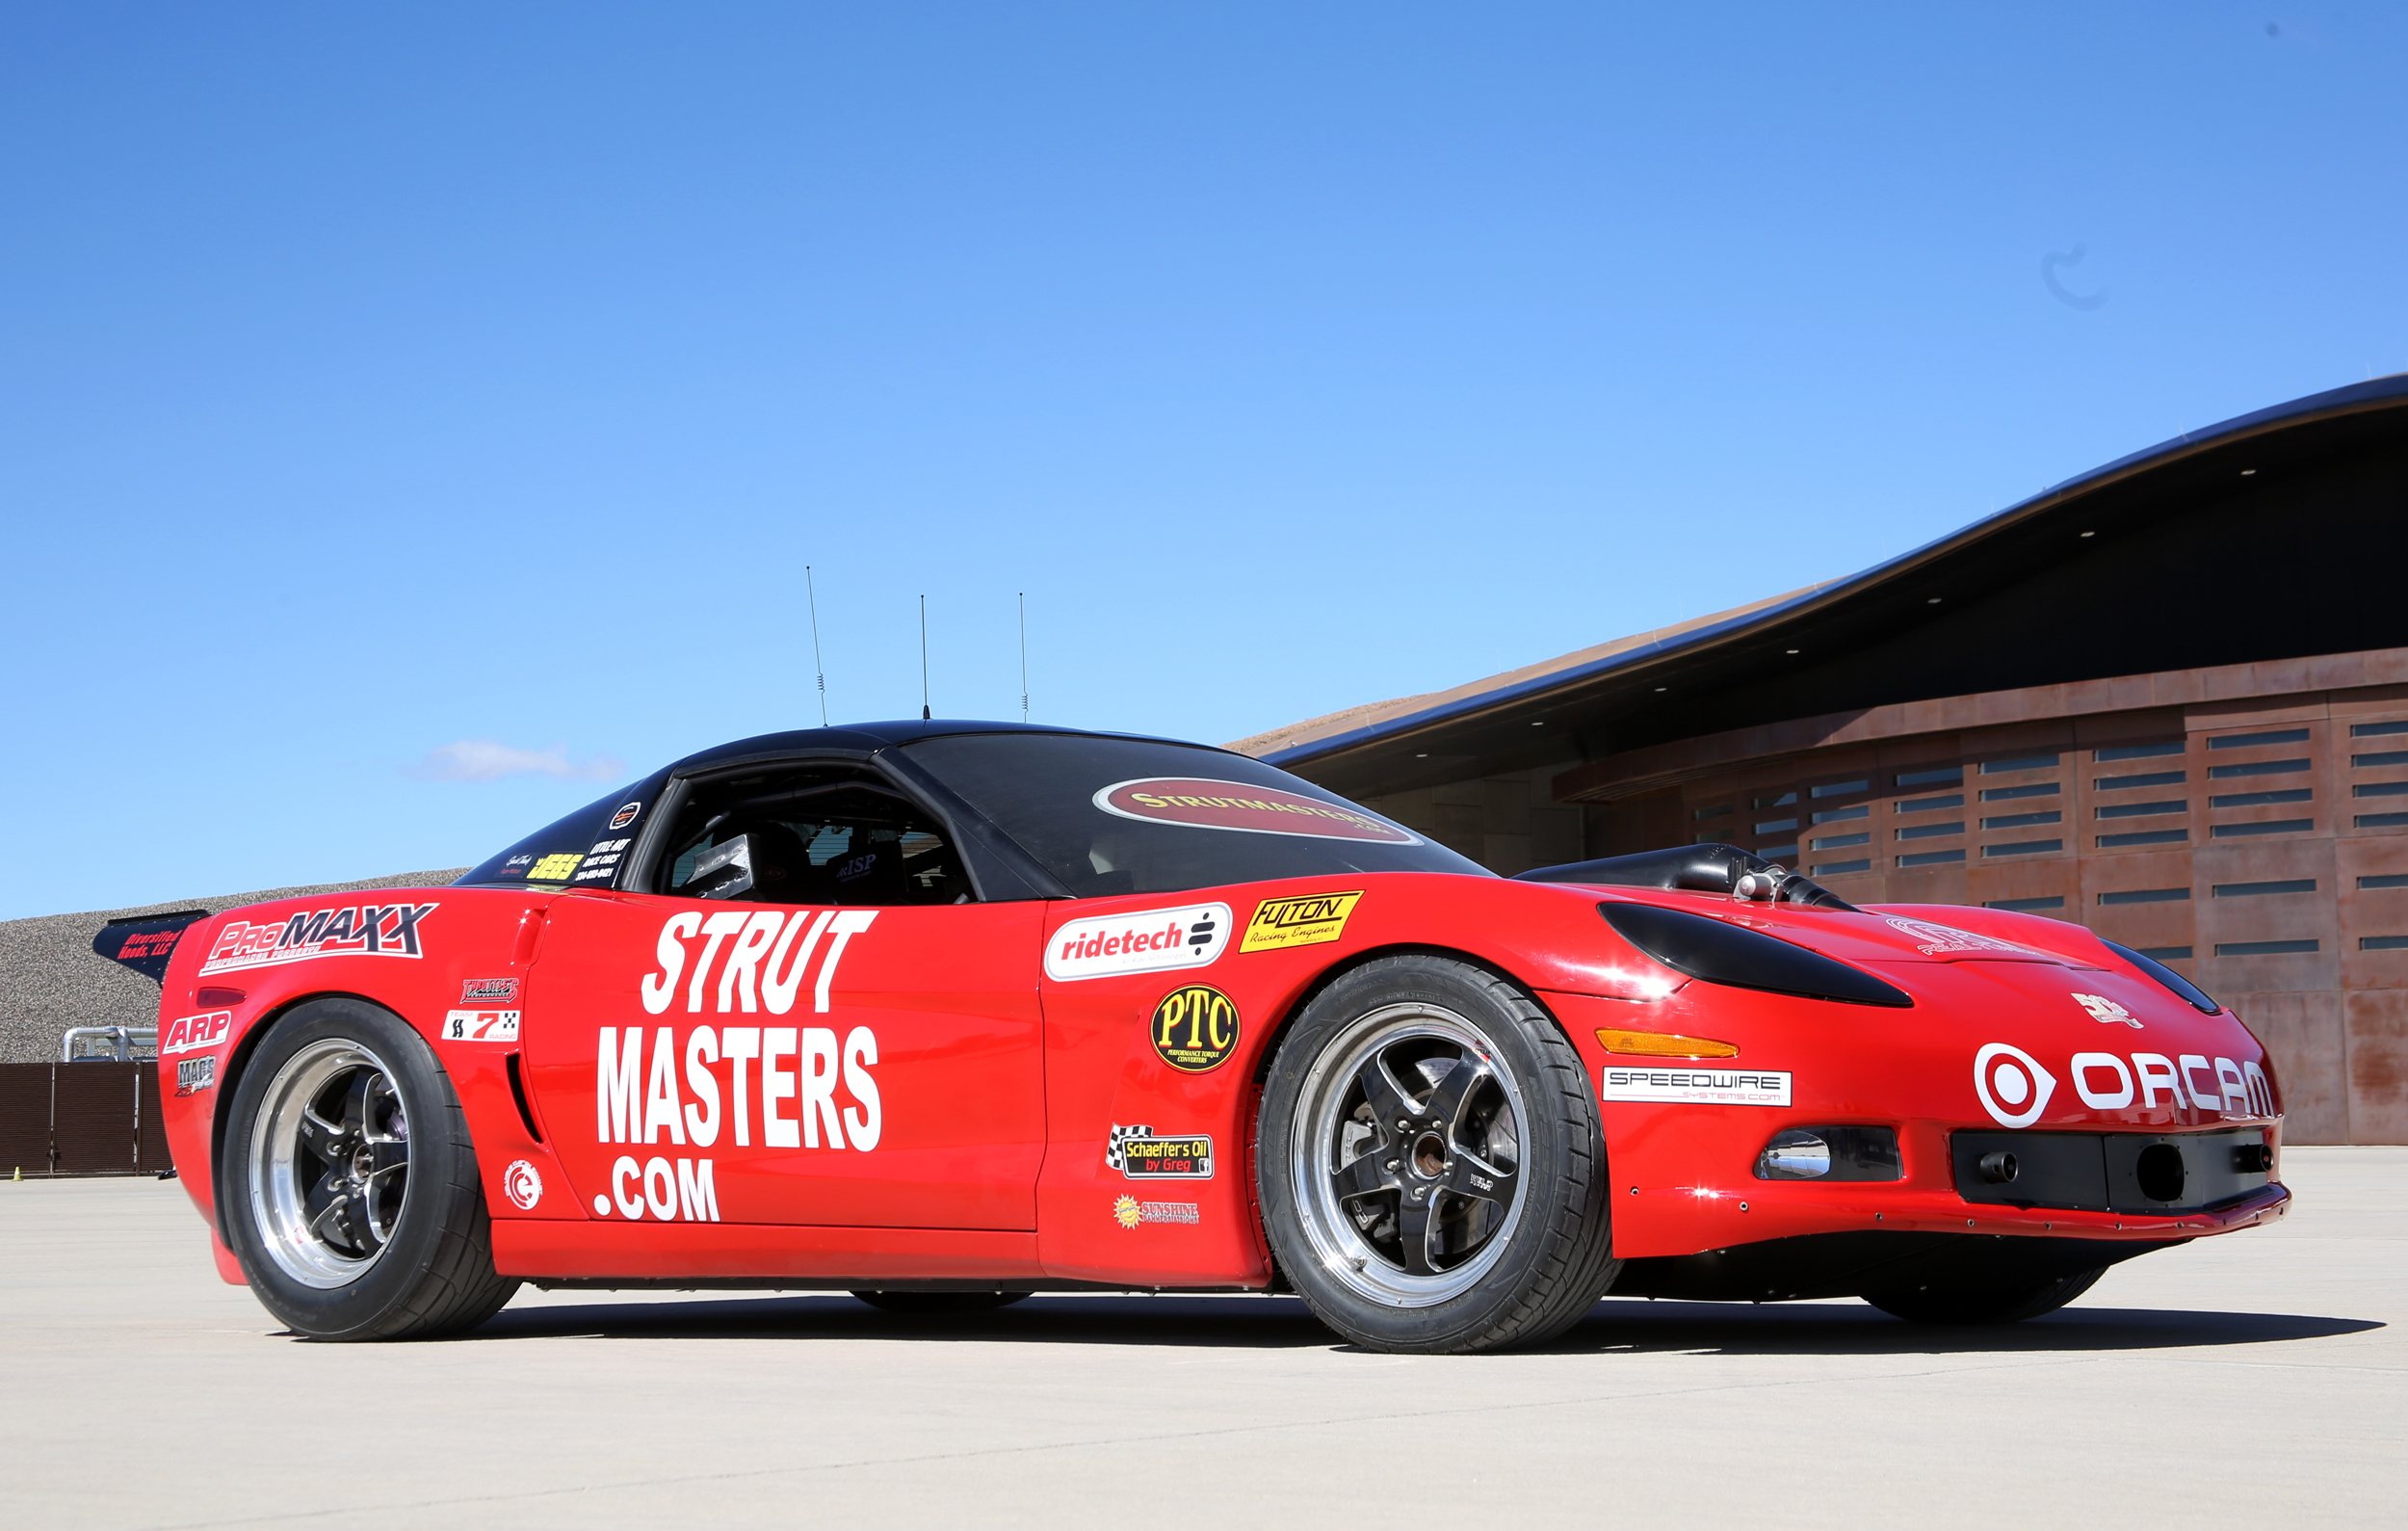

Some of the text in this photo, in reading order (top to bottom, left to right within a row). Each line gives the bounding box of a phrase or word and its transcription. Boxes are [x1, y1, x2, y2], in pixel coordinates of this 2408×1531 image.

[1131, 792, 1380, 829] STRUTMASTERS
[526, 854, 585, 881] JEGS
[599, 854, 621, 865] CARS
[848, 854, 877, 876] ISP
[1251, 898, 1344, 928] FULTON
[124, 930, 183, 946] Diversified
[1060, 921, 1184, 961] ridetech
[1249, 923, 1335, 944] Racing Engines
[118, 942, 173, 960] Hoods, LLC
[641, 910, 880, 1015] STRUT
[167, 1013, 229, 1047] ARP
[472, 1013, 500, 1039] 7
[1158, 989, 1232, 1050] PTC
[1166, 1048, 1219, 1059] PERFORMANCE TORQUE
[596, 1024, 882, 1152] MASTERS
[1610, 1071, 1781, 1090] SPEEDWIRE
[2071, 1051, 2276, 1120] ORCAM
[1682, 1092, 1781, 1101] SYSTEMS.COM
[1126, 1141, 1208, 1158] Schaeffer's Oil
[1145, 1157, 1191, 1173] by Greg
[593, 1155, 720, 1222] .COM
[1141, 1201, 1198, 1216] SUNSHINE
